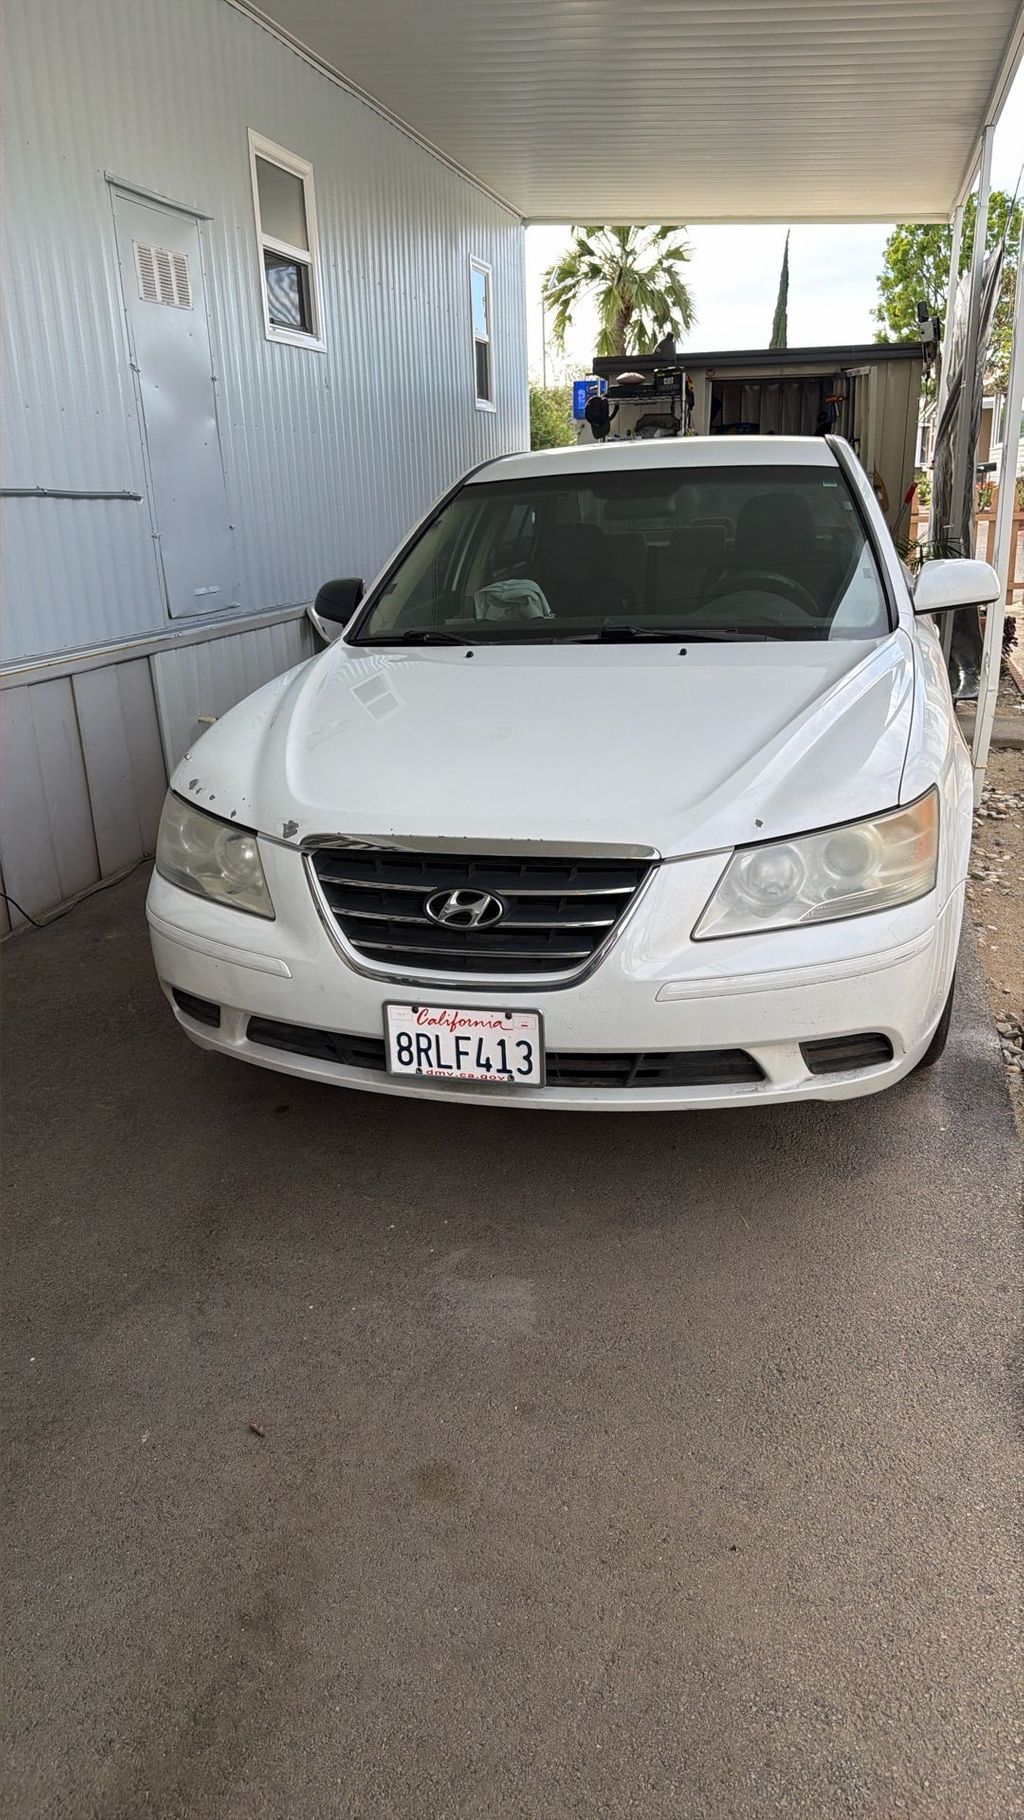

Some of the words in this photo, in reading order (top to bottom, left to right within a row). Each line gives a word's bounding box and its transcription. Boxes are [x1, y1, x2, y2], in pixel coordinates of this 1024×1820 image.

[417, 1008, 513, 1033] California
[396, 1032, 533, 1075] 8RLF413
[426, 1069, 505, 1081] dmv.ca.gov
